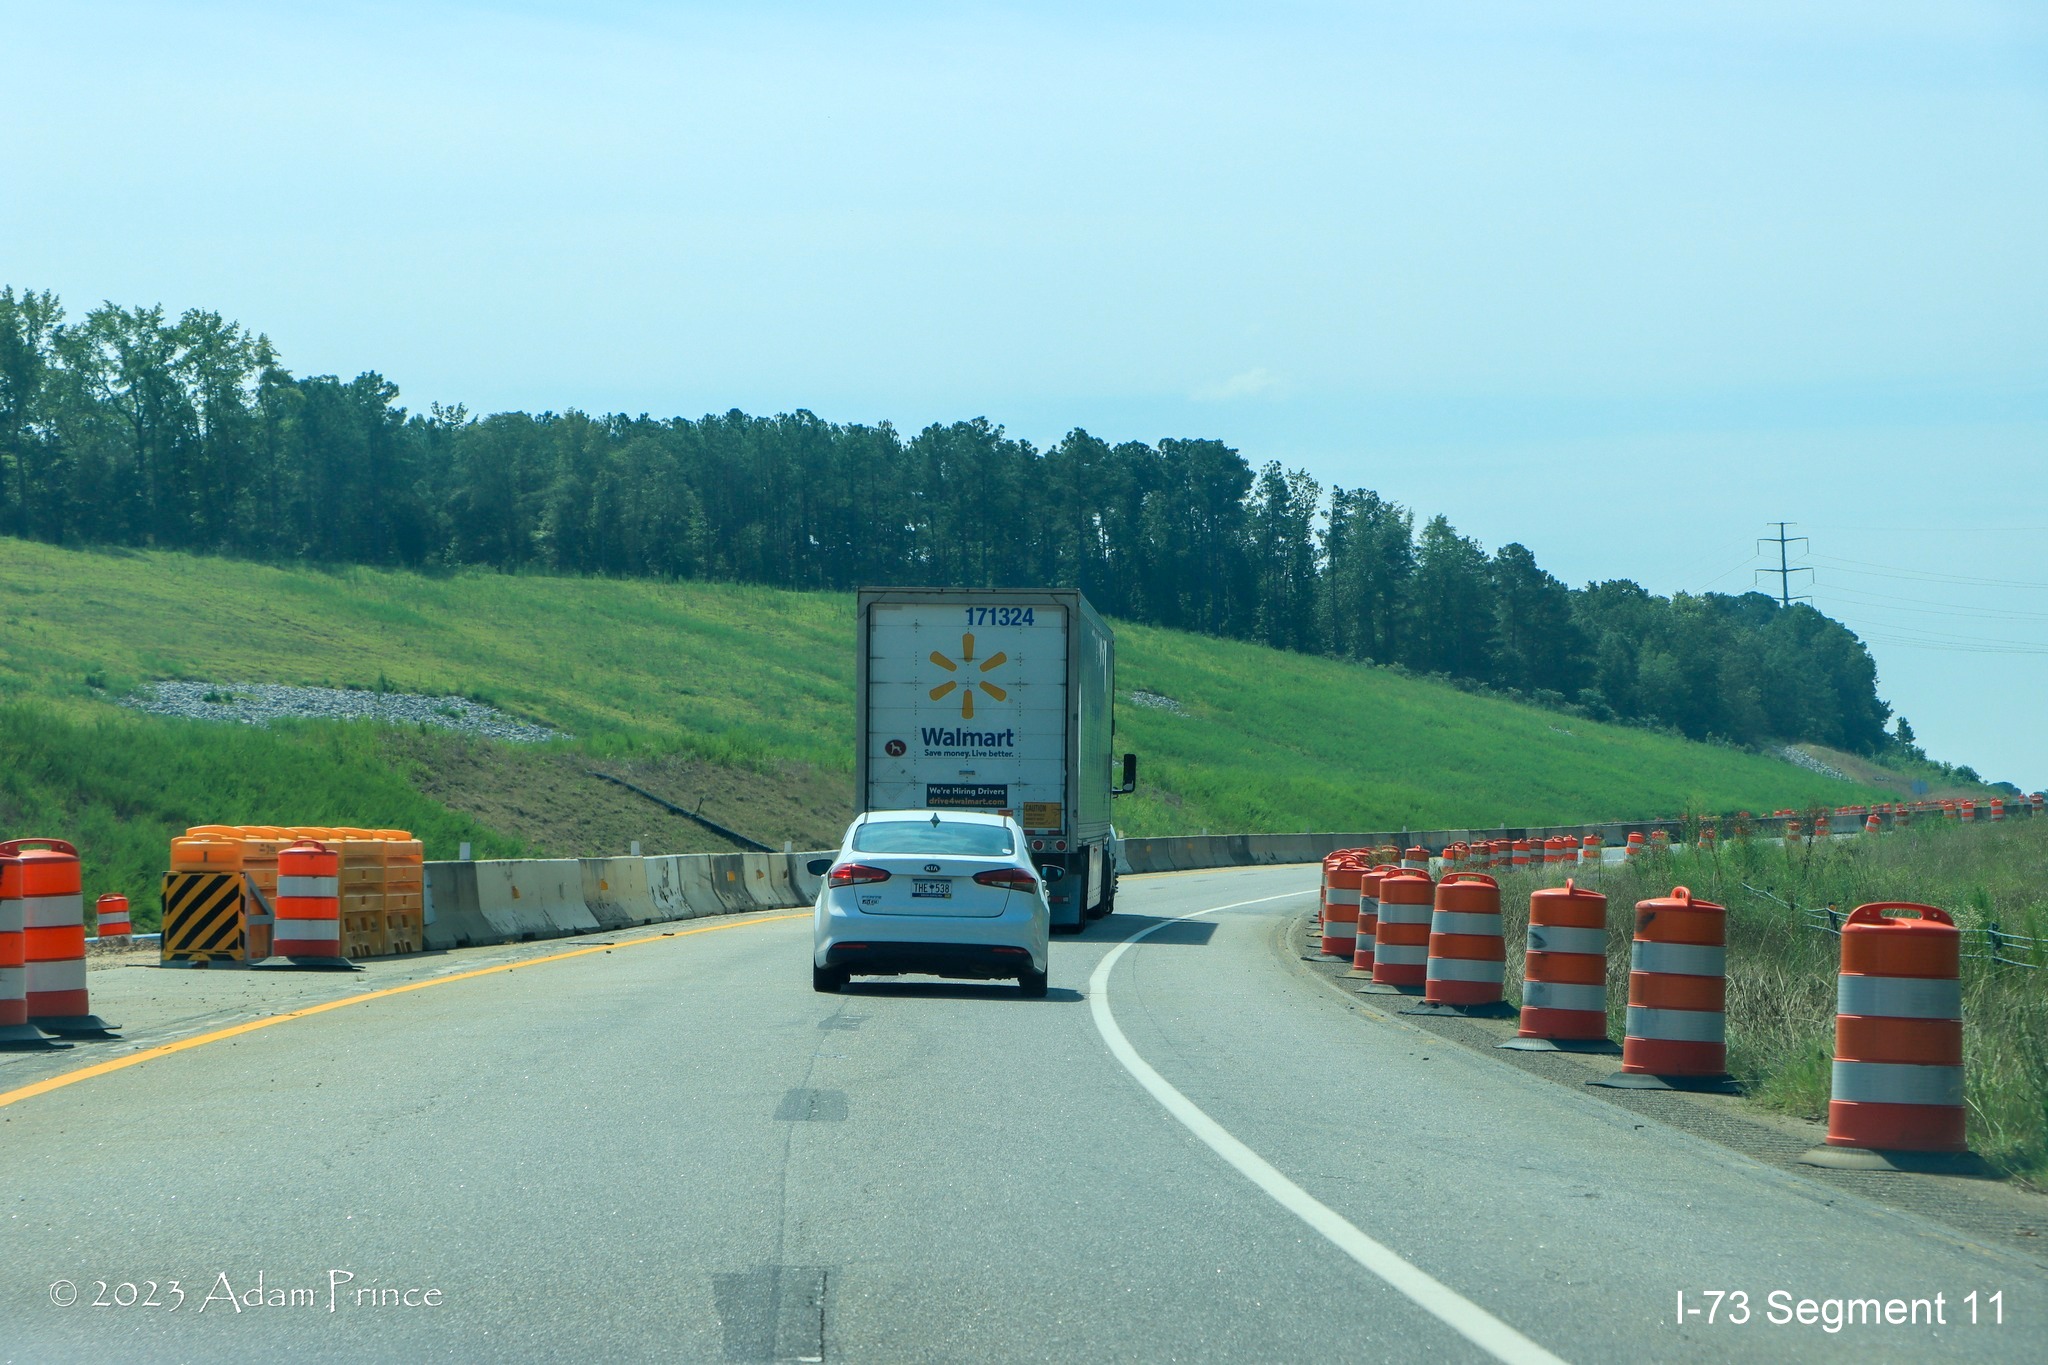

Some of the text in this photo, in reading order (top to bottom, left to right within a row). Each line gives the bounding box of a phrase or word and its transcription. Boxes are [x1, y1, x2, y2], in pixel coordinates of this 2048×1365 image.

[965, 607, 1035, 626] 171324
[921, 727, 1014, 748] Walmart
[924, 748, 1014, 760] Save money. Live better.
[929, 786, 1005, 797] We're Hiring Drivers
[928, 797, 1006, 806] drive4walmart.com
